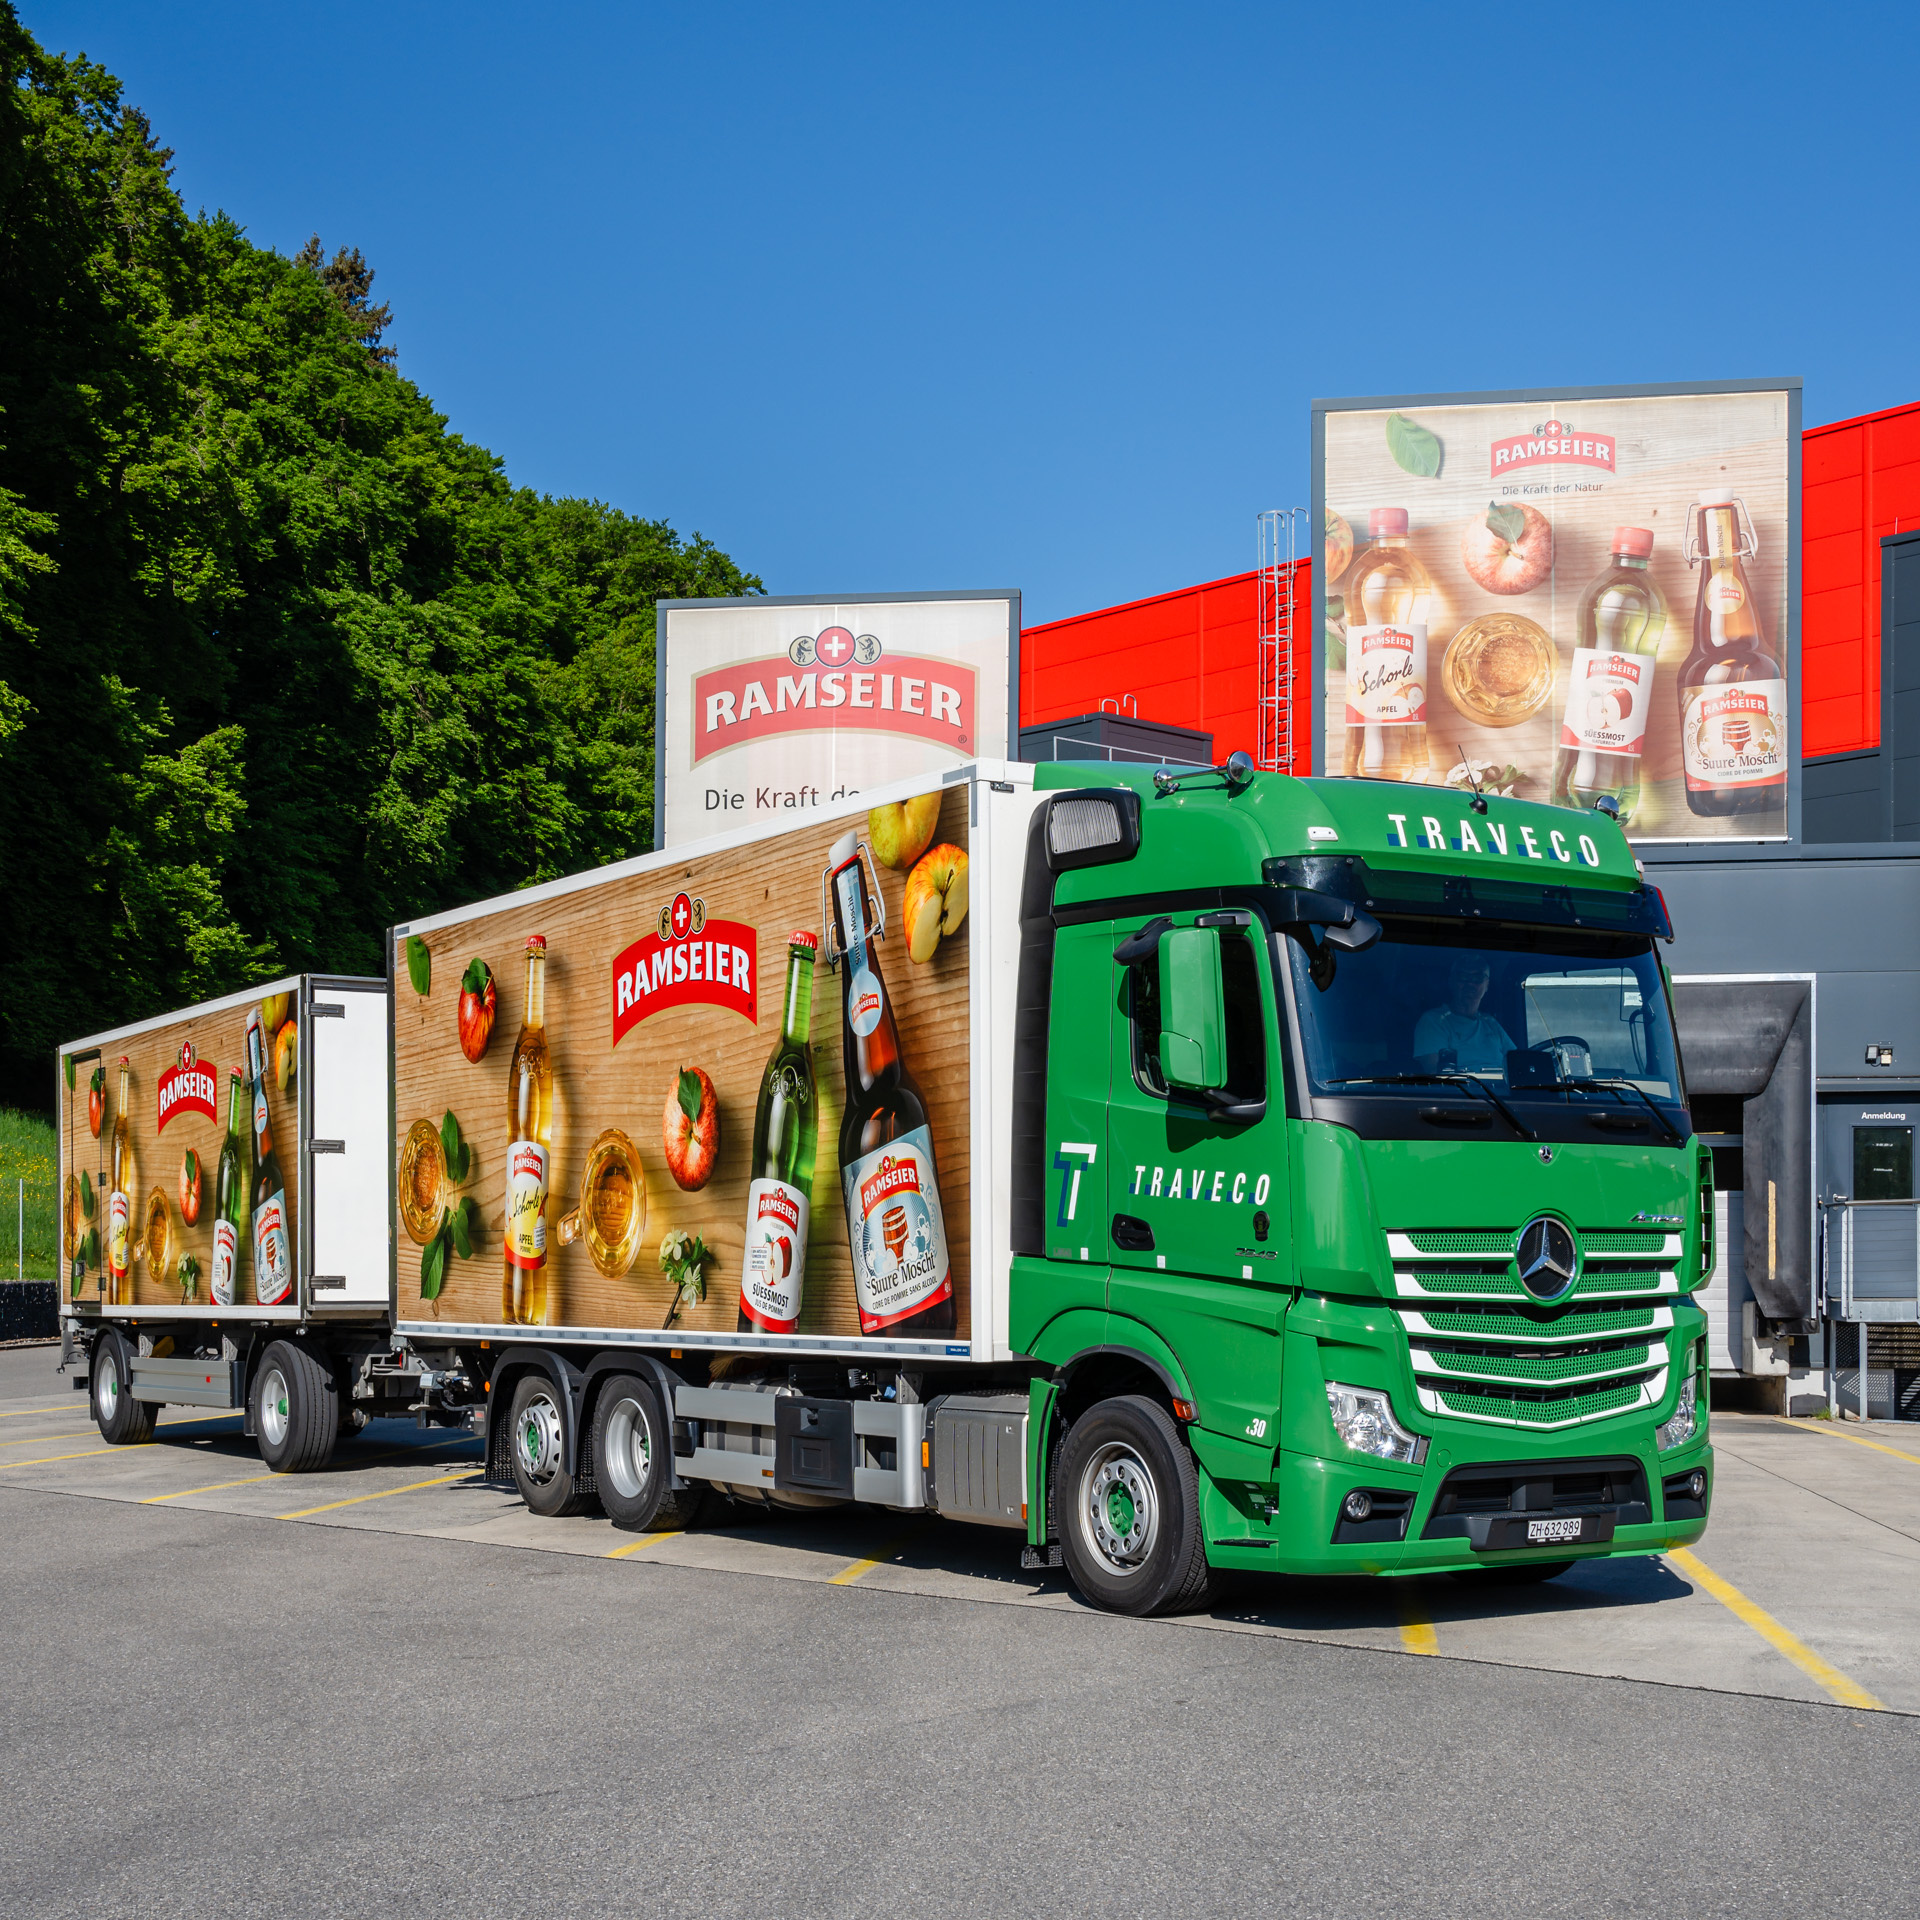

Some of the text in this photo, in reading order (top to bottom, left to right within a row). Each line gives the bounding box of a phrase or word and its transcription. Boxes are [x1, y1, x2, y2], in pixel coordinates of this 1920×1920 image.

[1495, 439, 1610, 467] RAMSEIER
[1502, 483, 1604, 495] Die Kraft der Natur
[1363, 636, 1412, 649] RAMSEIER
[1360, 655, 1414, 696] Schorle
[1589, 663, 1639, 678] RAMSEIER
[705, 672, 963, 733] RAMSEIER
[1376, 705, 1398, 713] APFEL
[1703, 698, 1766, 716] RAMSEIER
[1584, 728, 1626, 742] SÜESSMOST
[1702, 752, 1778, 770] Suure Moscht
[1742, 767, 1764, 775] POMME
[704, 788, 745, 811] Die
[755, 785, 821, 809] Kraft
[1387, 813, 1600, 867] TRAVECO
[848, 895, 858, 933] Moscht
[853, 934, 862, 965] Suure
[616, 940, 752, 1018] RAMSEIER
[159, 1072, 215, 1117] RAMSEIER
[1861, 1111, 1906, 1121] Anmeldung
[514, 1157, 542, 1175] RAMSEIER
[863, 1167, 917, 1208] RAMSEIER
[1130, 1165, 1271, 1206] TRAVECO
[513, 1185, 540, 1218] Schorle
[760, 1199, 797, 1226] RAMSEIER
[518, 1233, 533, 1246] APFEL
[870, 1252, 936, 1296] Suure Moscht
[752, 1281, 789, 1308] SÜESSMOST
[872, 1298, 884, 1310] CIDRE
[884, 1296, 891, 1306] DE
[891, 1289, 909, 1303] POMME
[909, 1283, 922, 1295] SANS
[921, 1275, 938, 1289] ALCOOL
[754, 1299, 784, 1316] JUS DE POMME
